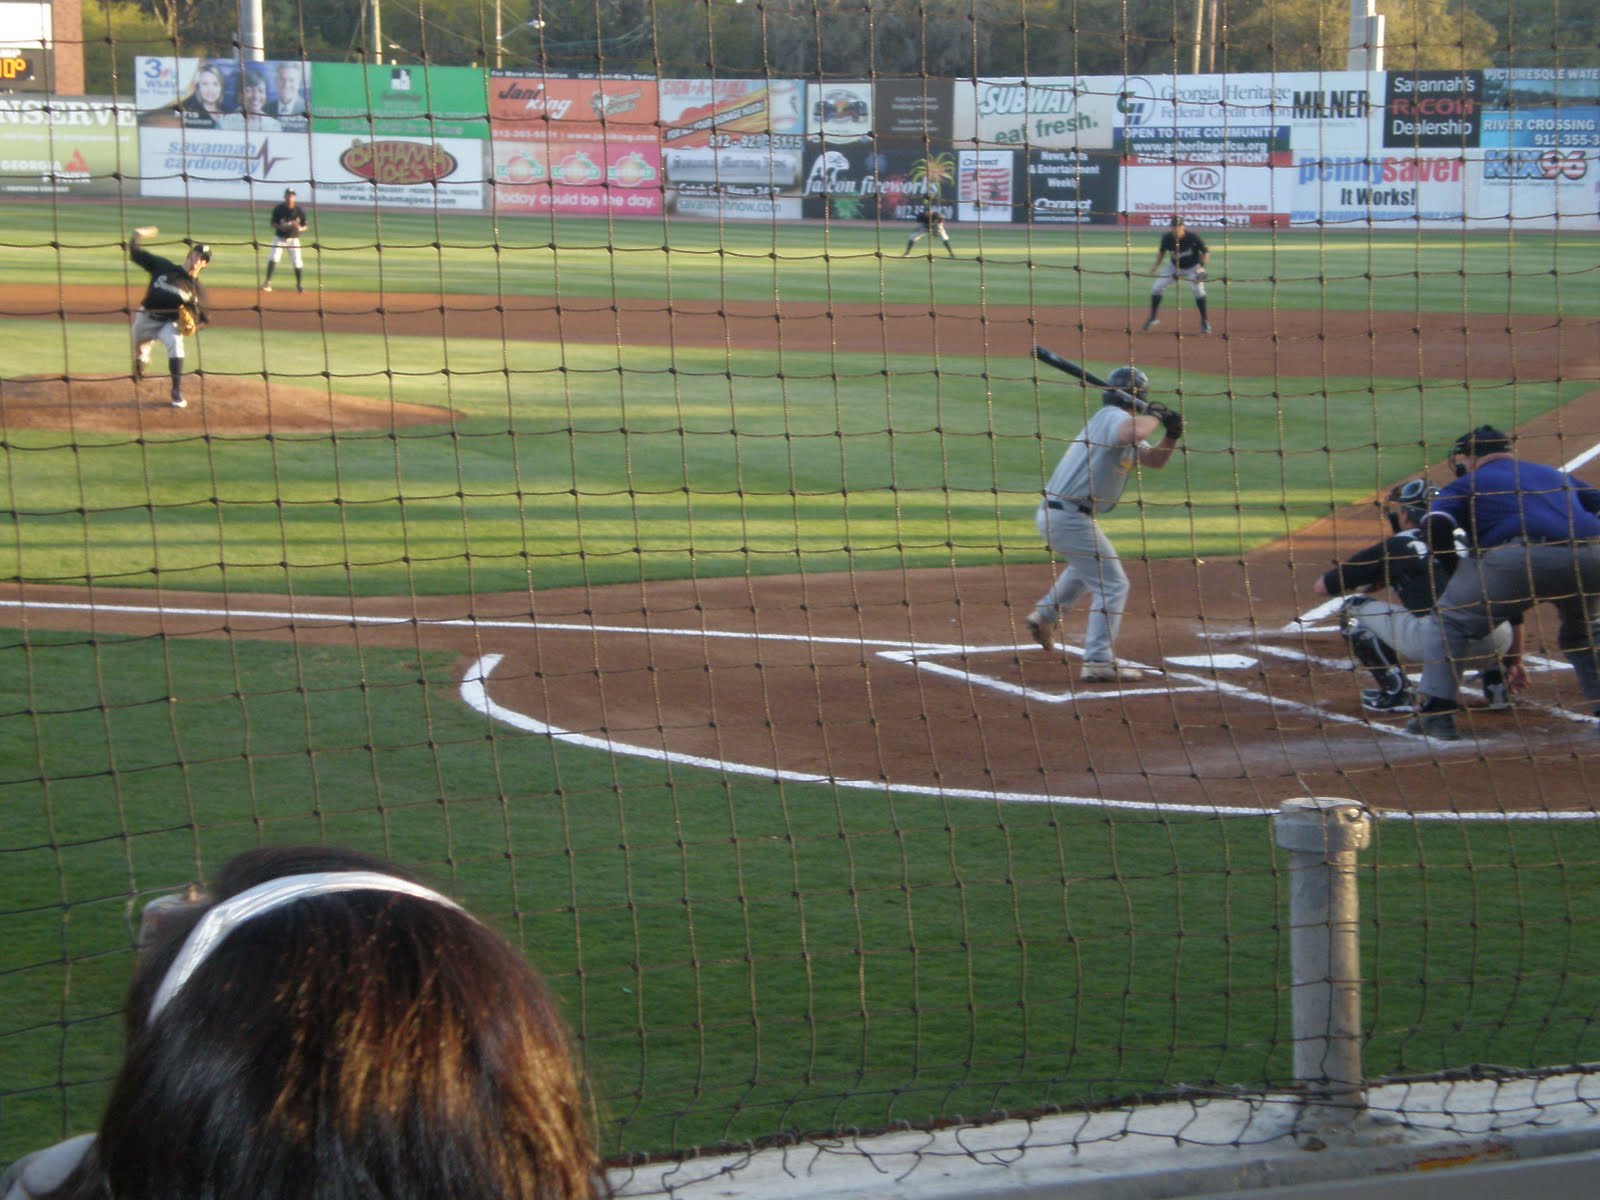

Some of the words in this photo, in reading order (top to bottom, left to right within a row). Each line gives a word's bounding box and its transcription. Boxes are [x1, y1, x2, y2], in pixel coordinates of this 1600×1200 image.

[144, 59, 161, 78] 3
[1567, 69, 1600, 80] WATE
[1393, 77, 1475, 92] Savannah's
[977, 80, 1088, 118] SUBWAY
[1161, 85, 1220, 101] Georgia
[1226, 85, 1291, 101] Heritage
[1161, 107, 1205, 118] Federal
[1292, 90, 1370, 119] MILNER
[995, 124, 1027, 143] eat
[1035, 111, 1099, 138] fresh.
[1123, 127, 1155, 138] OPEN
[1158, 127, 1174, 138] TO
[1178, 127, 1201, 138] THE
[1203, 127, 1280, 138] COMMUNITY
[1393, 120, 1473, 136] Dealership
[1484, 119, 1523, 131] RIVER
[1526, 119, 1595, 131] CROSSING
[168, 140, 257, 155] savannah
[163, 157, 260, 174] cardiology
[1298, 156, 1465, 185] pennysaver
[1188, 173, 1214, 185] KIA
[580, 193, 599, 206] be
[1340, 188, 1353, 206] It
[1356, 187, 1416, 206] Works!
